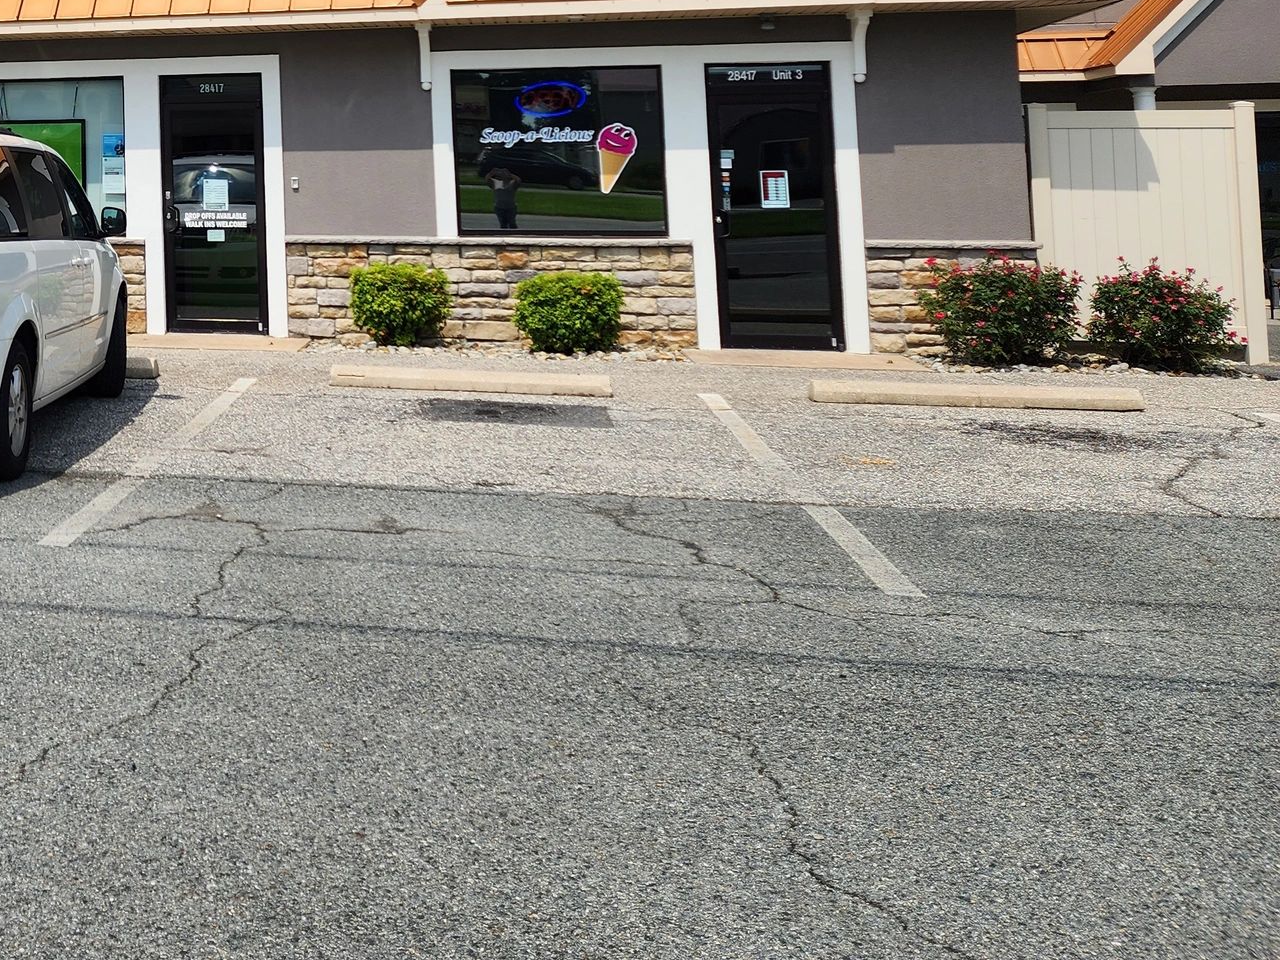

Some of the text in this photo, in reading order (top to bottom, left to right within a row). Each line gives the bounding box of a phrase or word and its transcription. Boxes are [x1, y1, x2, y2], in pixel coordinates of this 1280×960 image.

[727, 69, 803, 81] 28417 Unit 3
[199, 83, 224, 93] 28417
[480, 126, 595, 148] Scoop-a-Licious
[184, 212, 247, 220] DROP OFFS AVAILABLE
